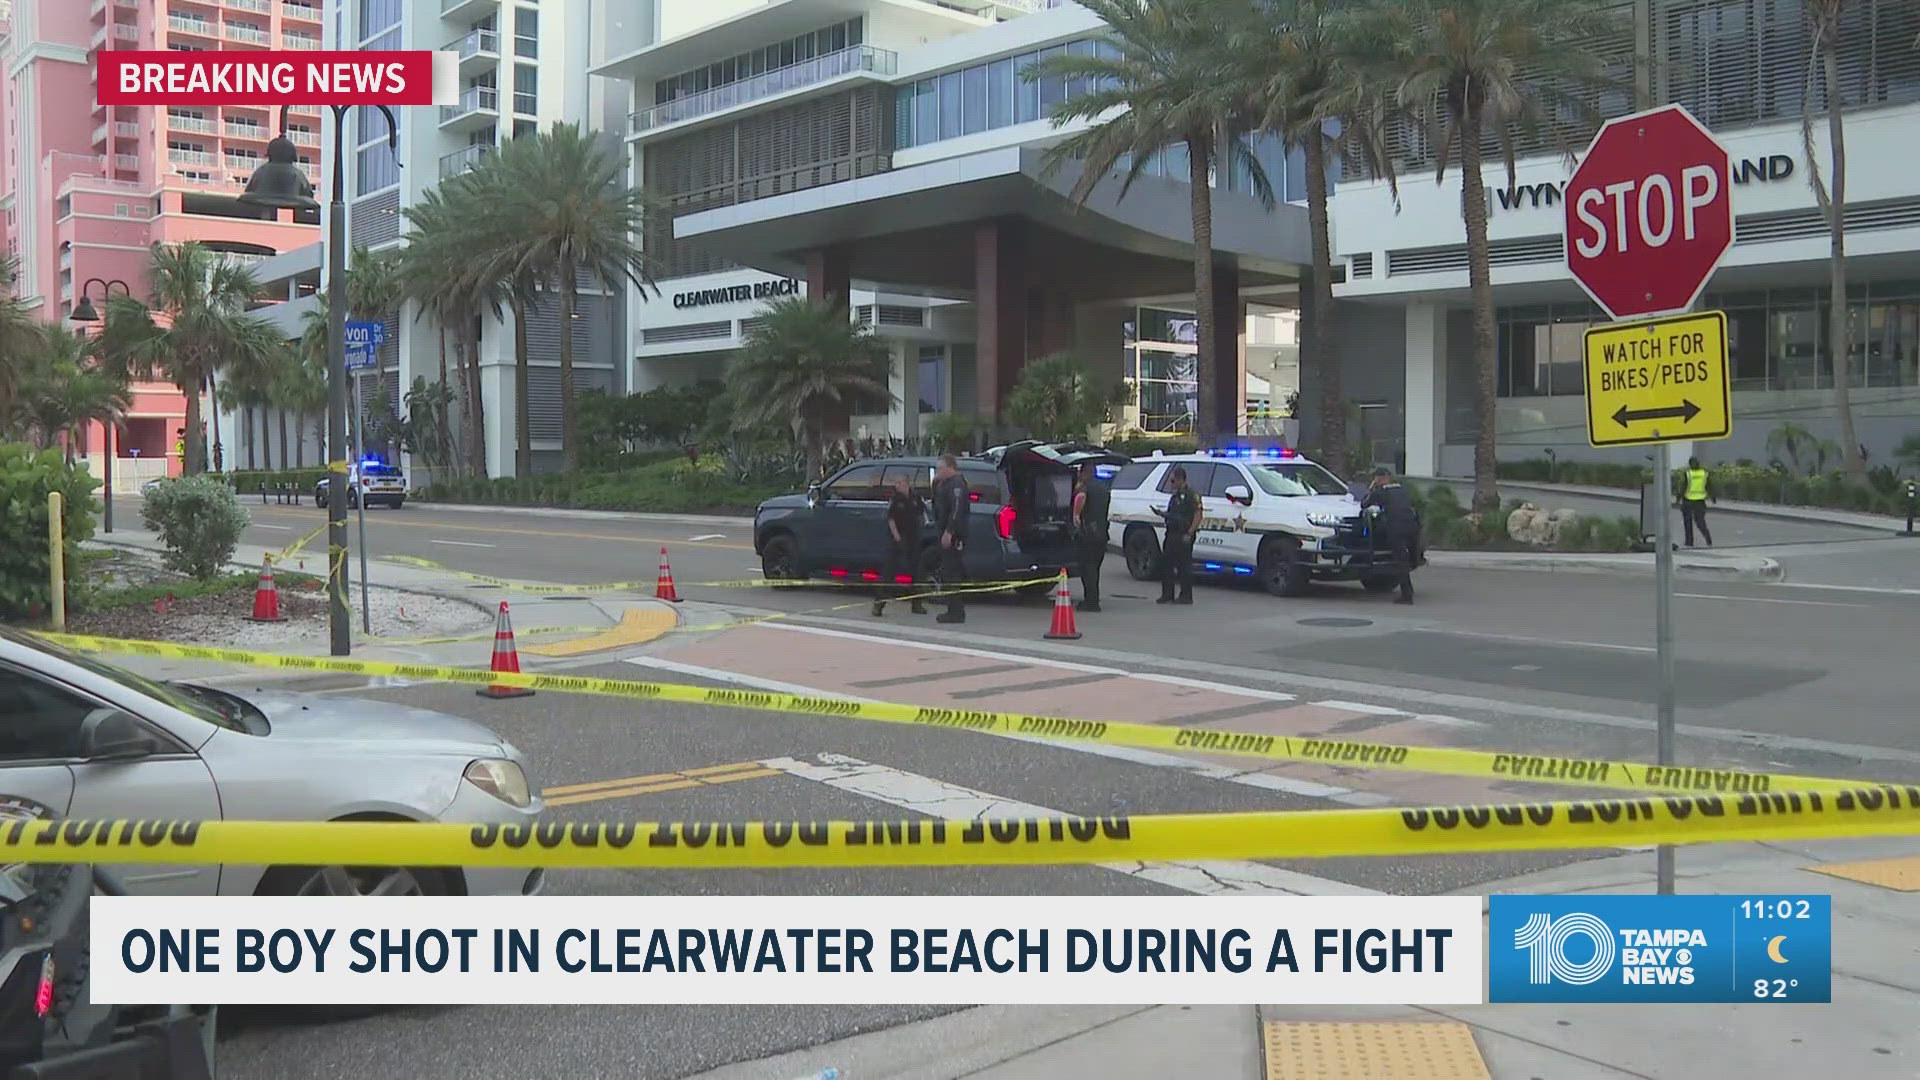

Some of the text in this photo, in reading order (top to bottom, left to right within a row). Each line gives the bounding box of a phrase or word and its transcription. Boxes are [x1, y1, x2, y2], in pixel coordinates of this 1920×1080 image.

[1497, 181, 1566, 210] WYN
[1575, 164, 1719, 260] STOP
[673, 278, 799, 309] CLEARWATER BEACH
[344, 327, 369, 341] von
[1602, 333, 1705, 364] WATCH FOR
[1601, 361, 1709, 392] BIKES/PEDS
